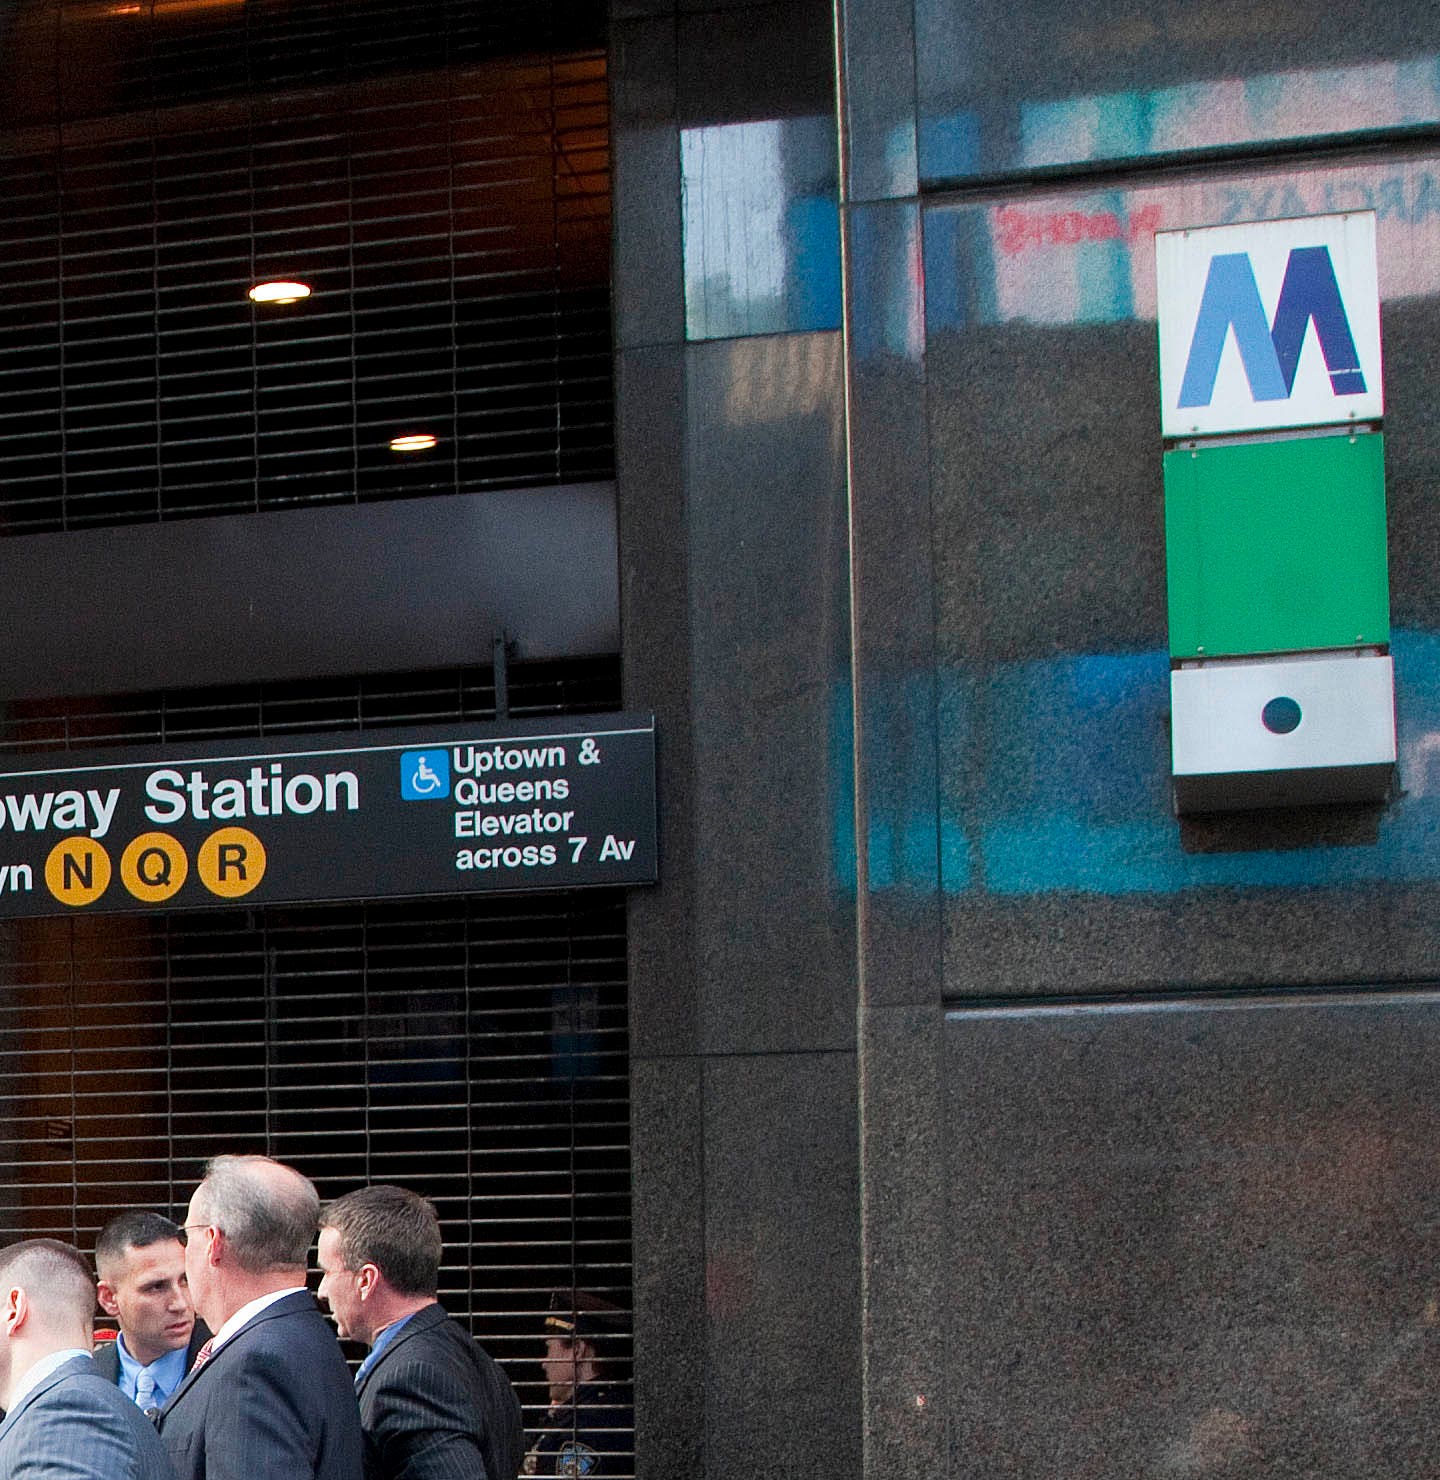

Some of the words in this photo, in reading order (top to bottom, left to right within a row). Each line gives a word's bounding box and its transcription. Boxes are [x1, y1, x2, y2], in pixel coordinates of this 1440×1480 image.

[454, 745, 566, 778] Uptown
[578, 738, 602, 766] &
[143, 762, 360, 825] Station
[454, 777, 570, 807] Queens
[455, 806, 576, 839] Elevator
[62, 852, 94, 890] N
[136, 846, 173, 888] Q
[218, 843, 248, 881] R
[456, 841, 557, 871] across
[568, 836, 588, 863] 7
[598, 835, 636, 862] Av
